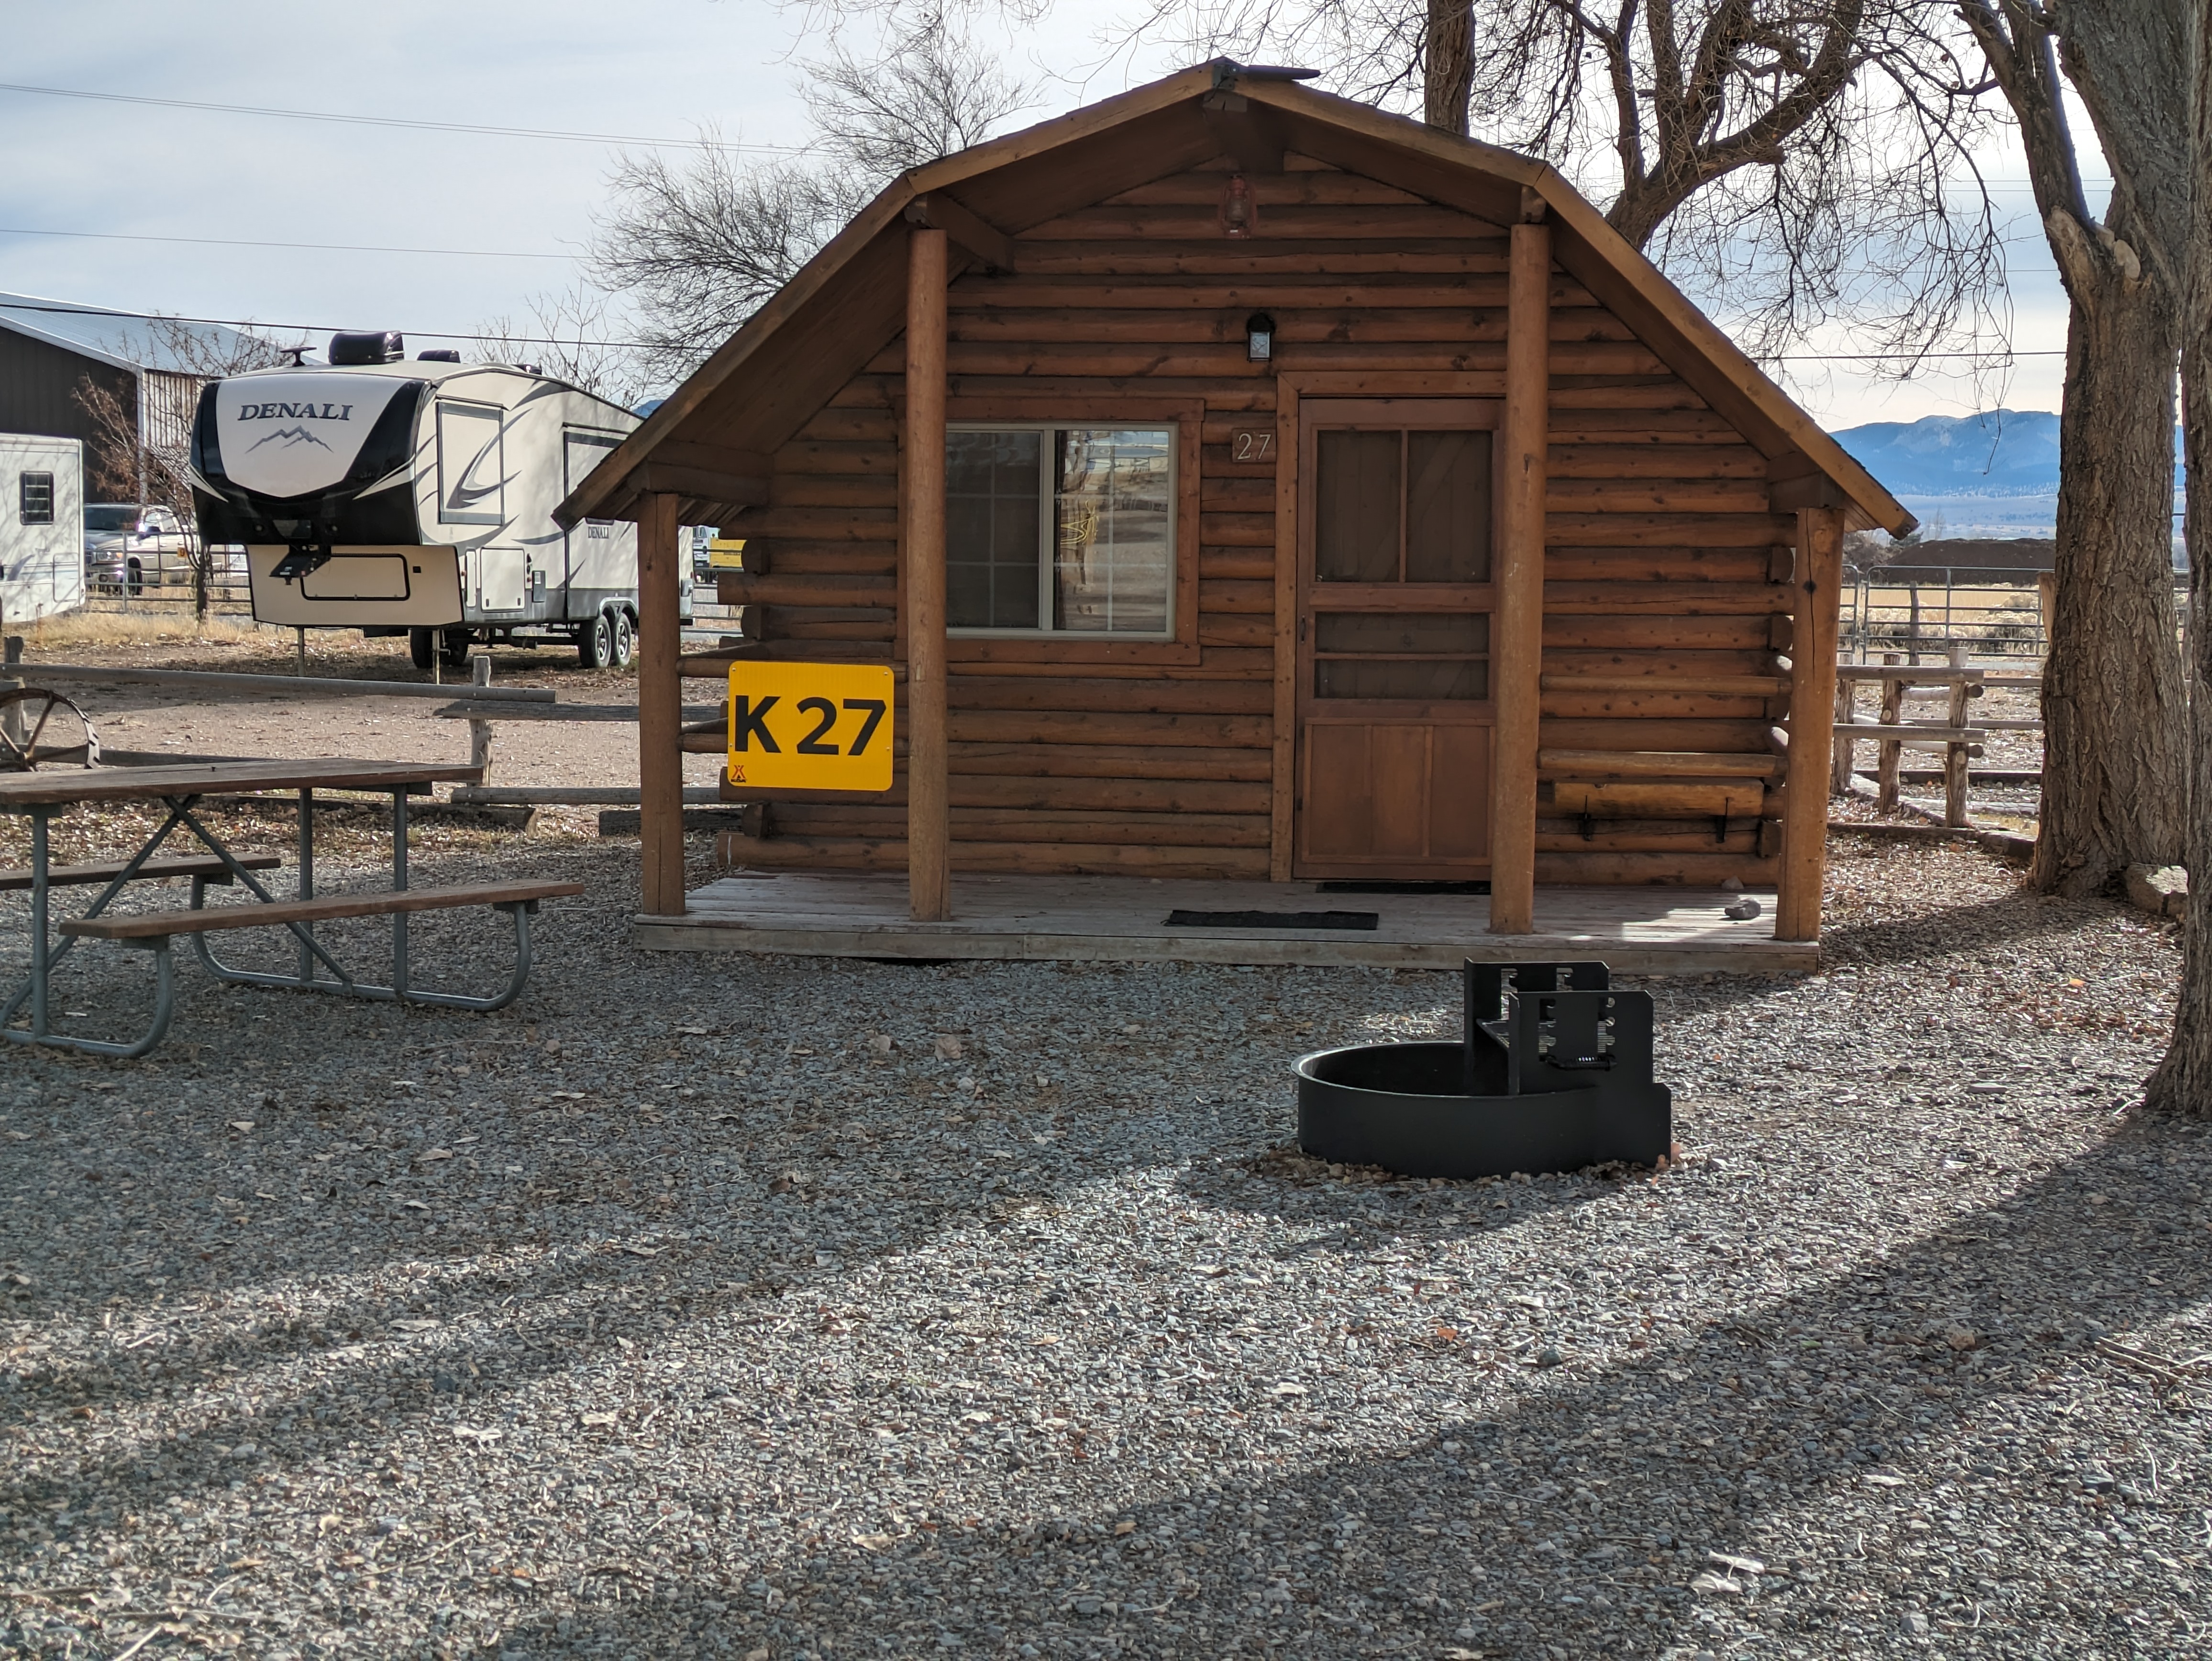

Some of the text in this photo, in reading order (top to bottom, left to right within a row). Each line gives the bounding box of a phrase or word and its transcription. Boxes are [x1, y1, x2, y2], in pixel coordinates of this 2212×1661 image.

[237, 403, 353, 421] DENALI
[1238, 433, 1271, 460] 27
[588, 526, 609, 539] DENALI
[735, 695, 886, 756] K 27
